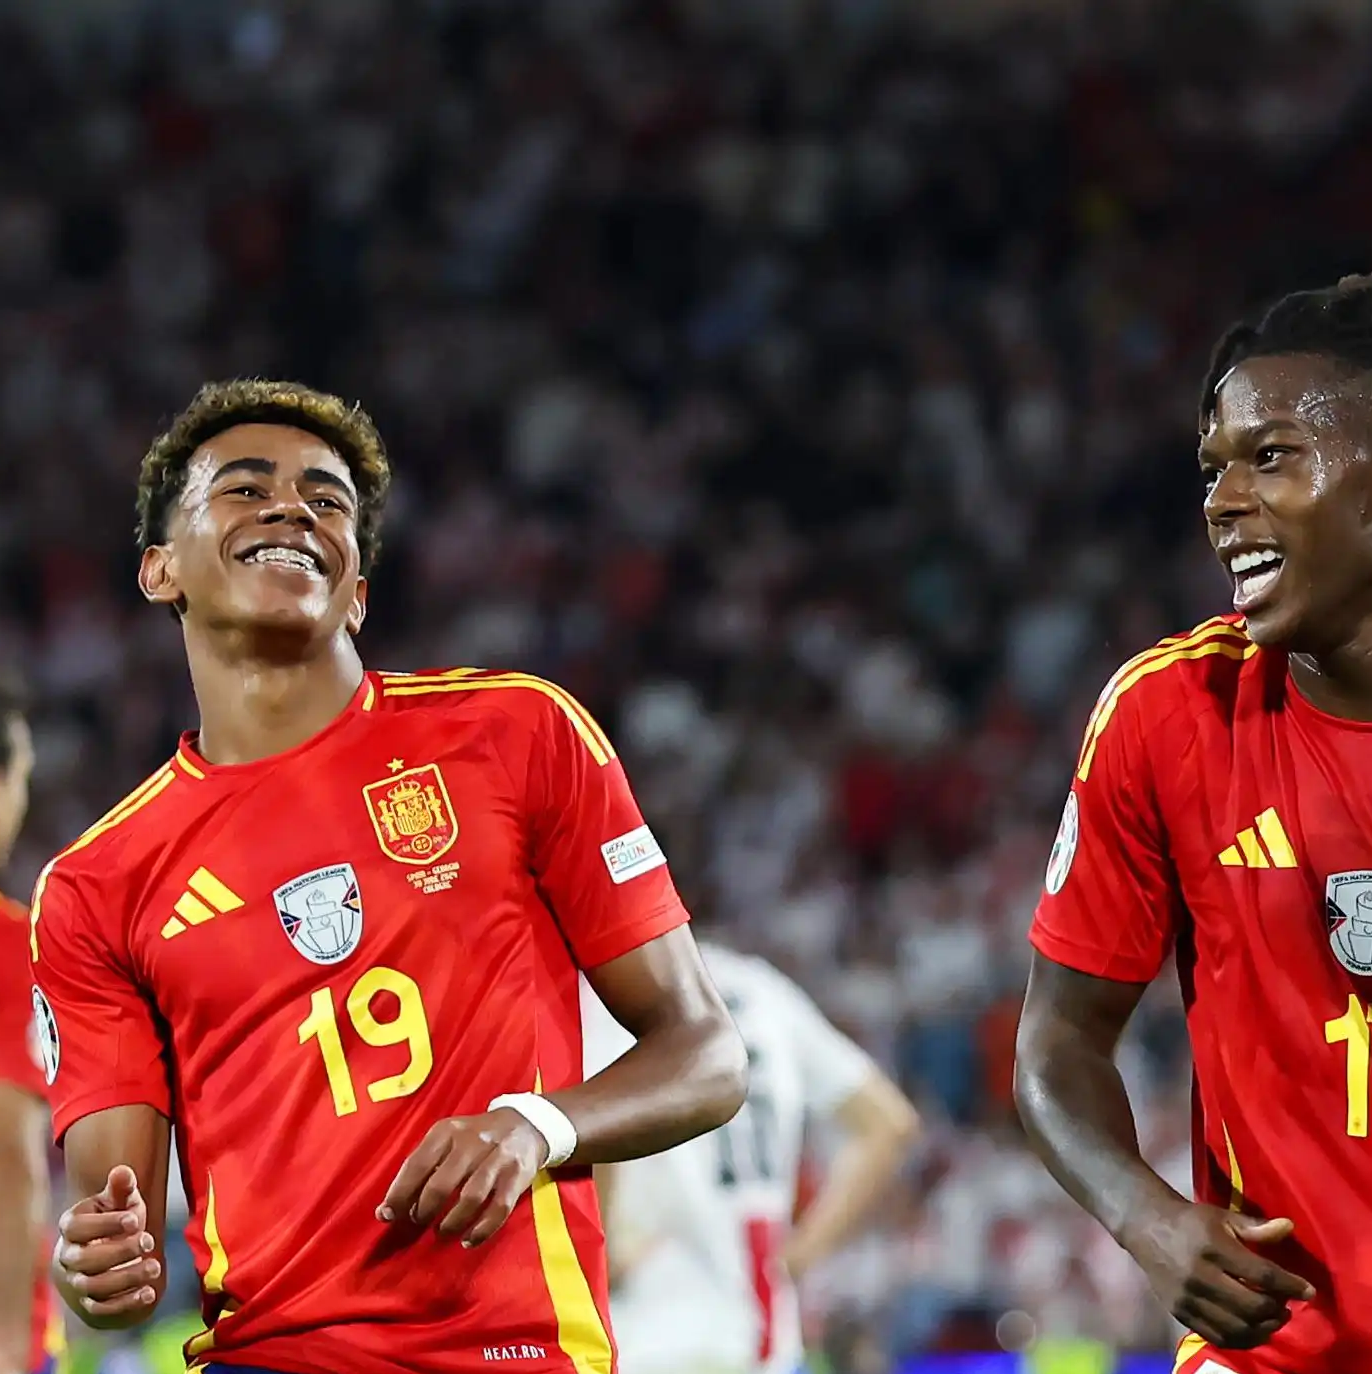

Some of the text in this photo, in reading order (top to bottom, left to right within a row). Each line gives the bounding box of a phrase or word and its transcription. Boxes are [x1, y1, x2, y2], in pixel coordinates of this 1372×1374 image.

[606, 841, 626, 854] UEFA
[298, 966, 434, 1118] 19
[483, 1344, 547, 1361] HEAT.RDY
